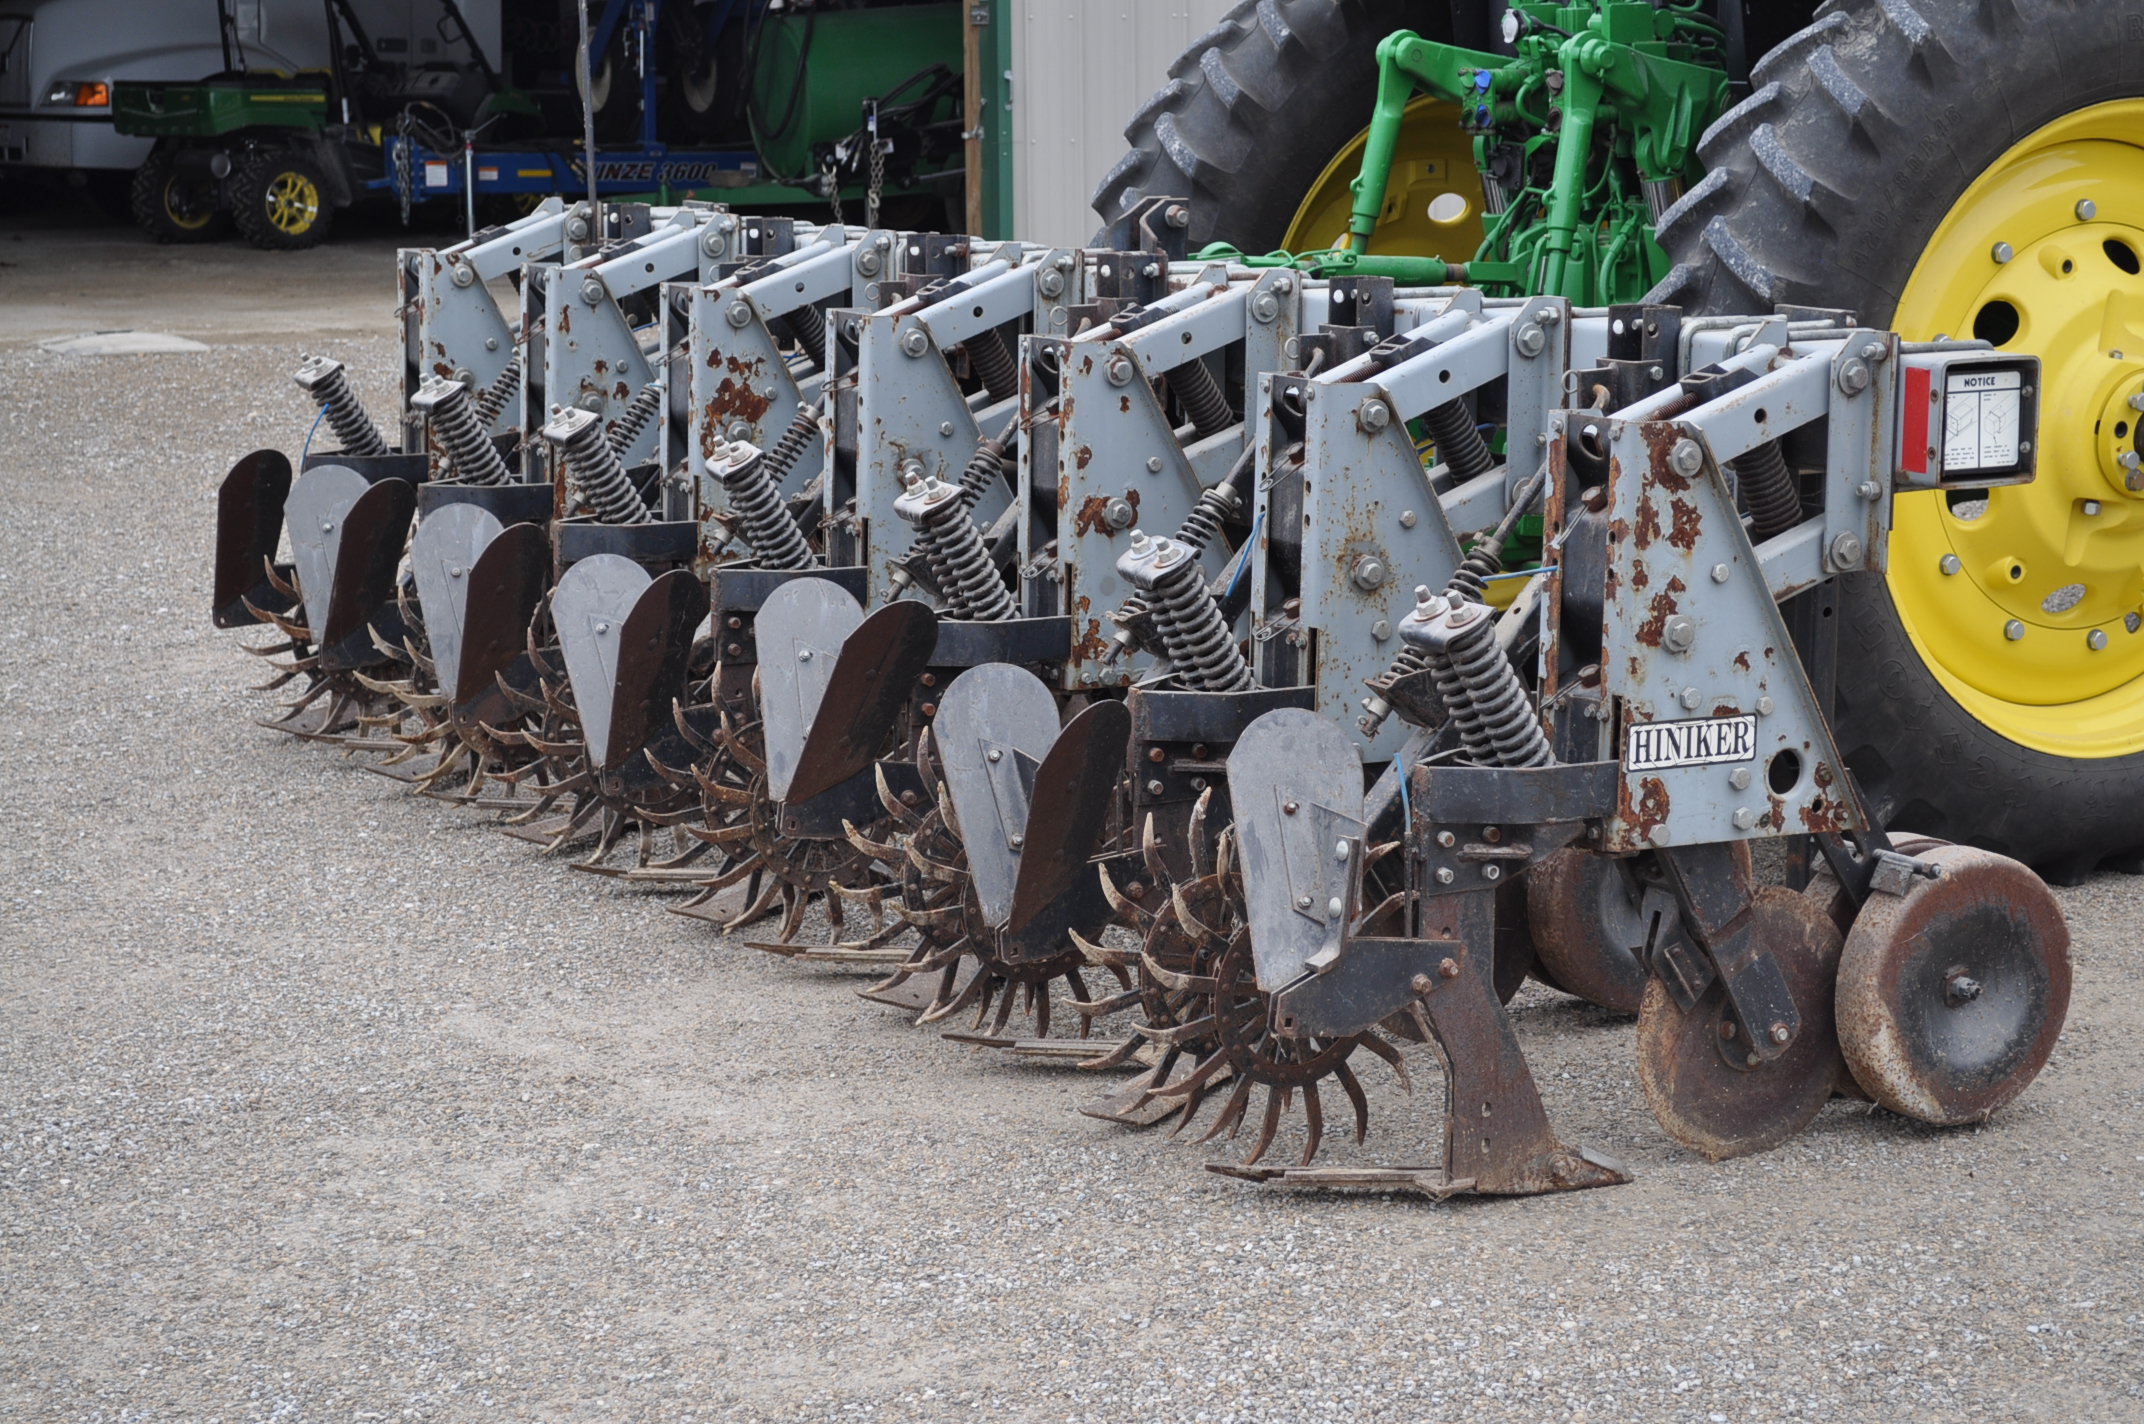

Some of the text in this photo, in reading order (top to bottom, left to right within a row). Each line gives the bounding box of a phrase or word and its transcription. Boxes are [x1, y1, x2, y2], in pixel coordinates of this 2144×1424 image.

[595, 161, 656, 181] INZE
[657, 161, 718, 181] 3600
[1964, 376, 1996, 388] NOTICE
[1633, 721, 1750, 764] HINIKER
